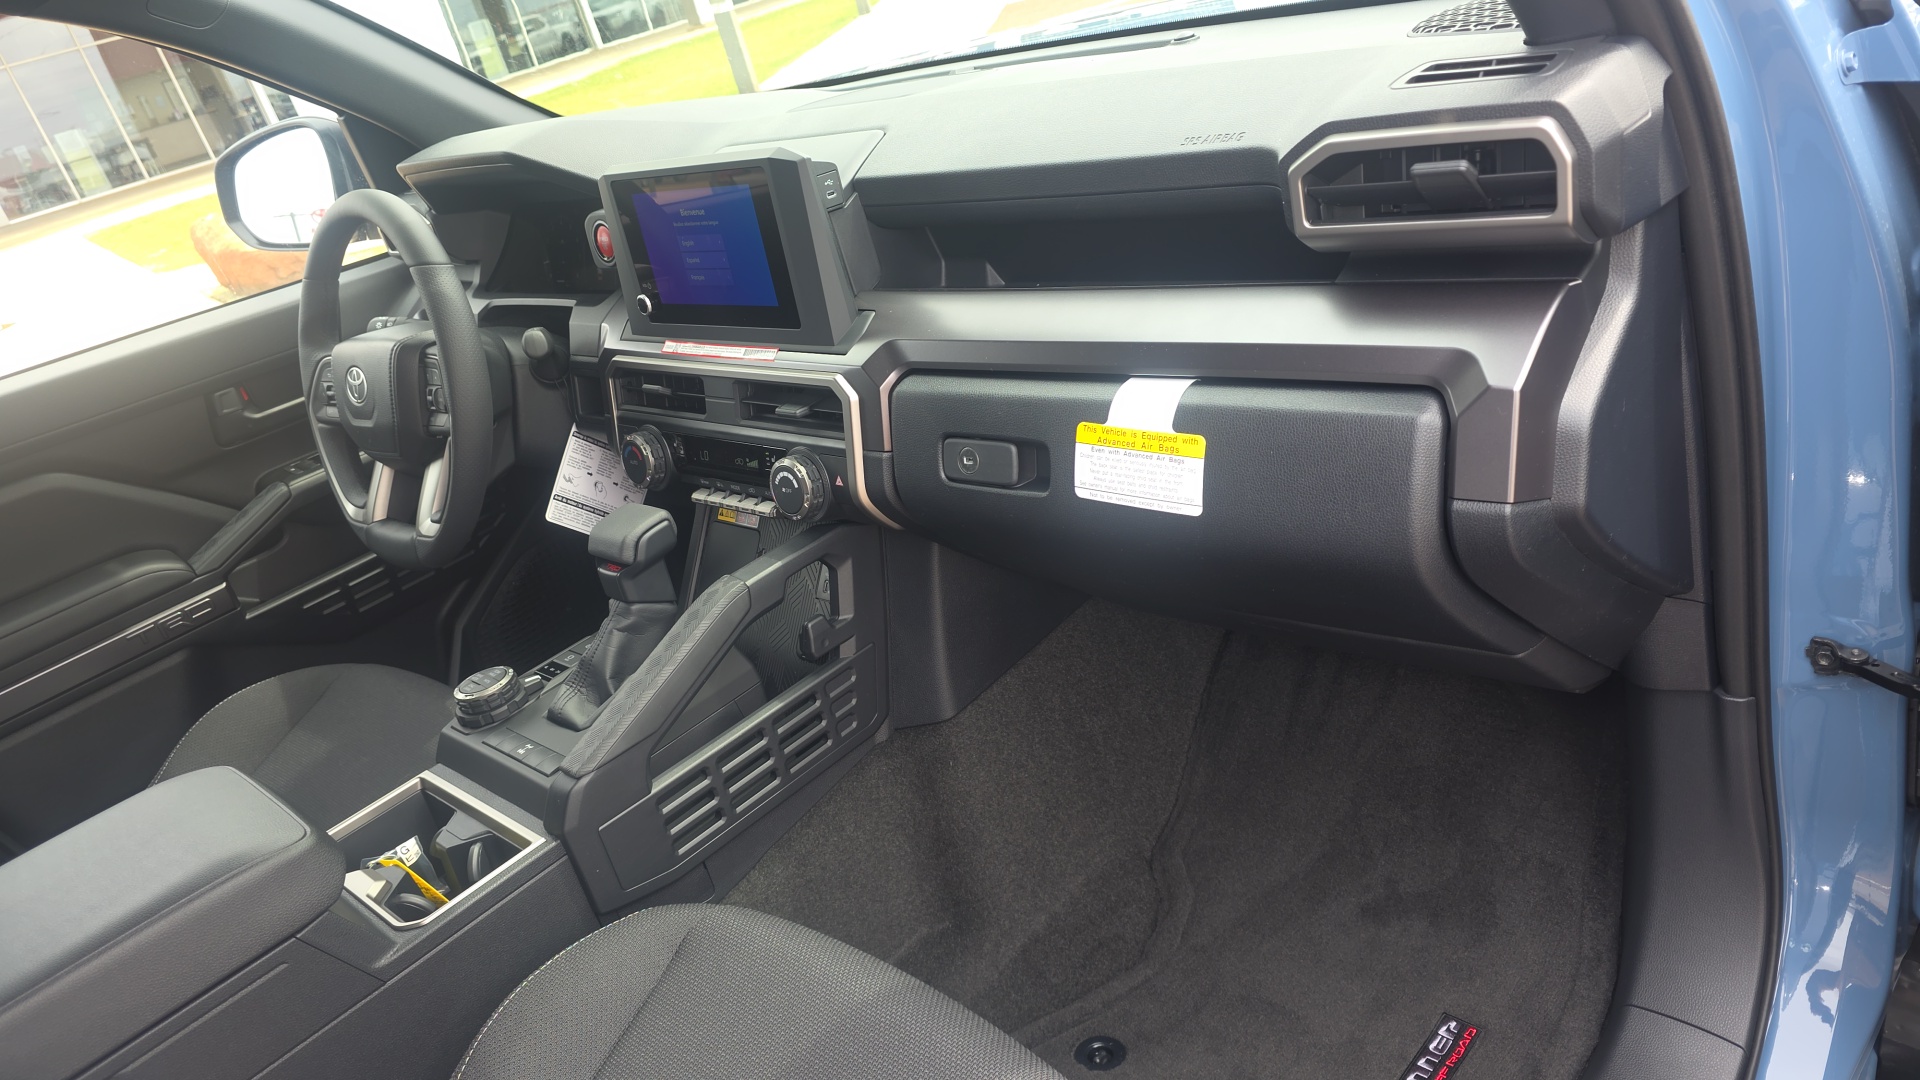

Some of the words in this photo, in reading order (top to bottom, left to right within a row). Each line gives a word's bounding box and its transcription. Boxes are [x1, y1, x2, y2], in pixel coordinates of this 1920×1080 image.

[680, 208, 705, 216] Bienvenue
[1083, 424, 1097, 433] This
[1102, 427, 1126, 437] Vehicle
[1131, 430, 1137, 438] is
[1142, 432, 1177, 444] Equipped
[1182, 437, 1198, 446] with
[1097, 437, 1135, 448] Advanced
[1159, 444, 1180, 454] Bags
[1108, 448, 1120, 456] with
[1124, 450, 1153, 460] Advanced
[1169, 456, 1185, 465] Bags
[1116, 496, 1136, 504] removed
[1139, 500, 1155, 508] except
[126, 598, 216, 645] TRD
[1445, 1027, 1477, 1067] ROAD
